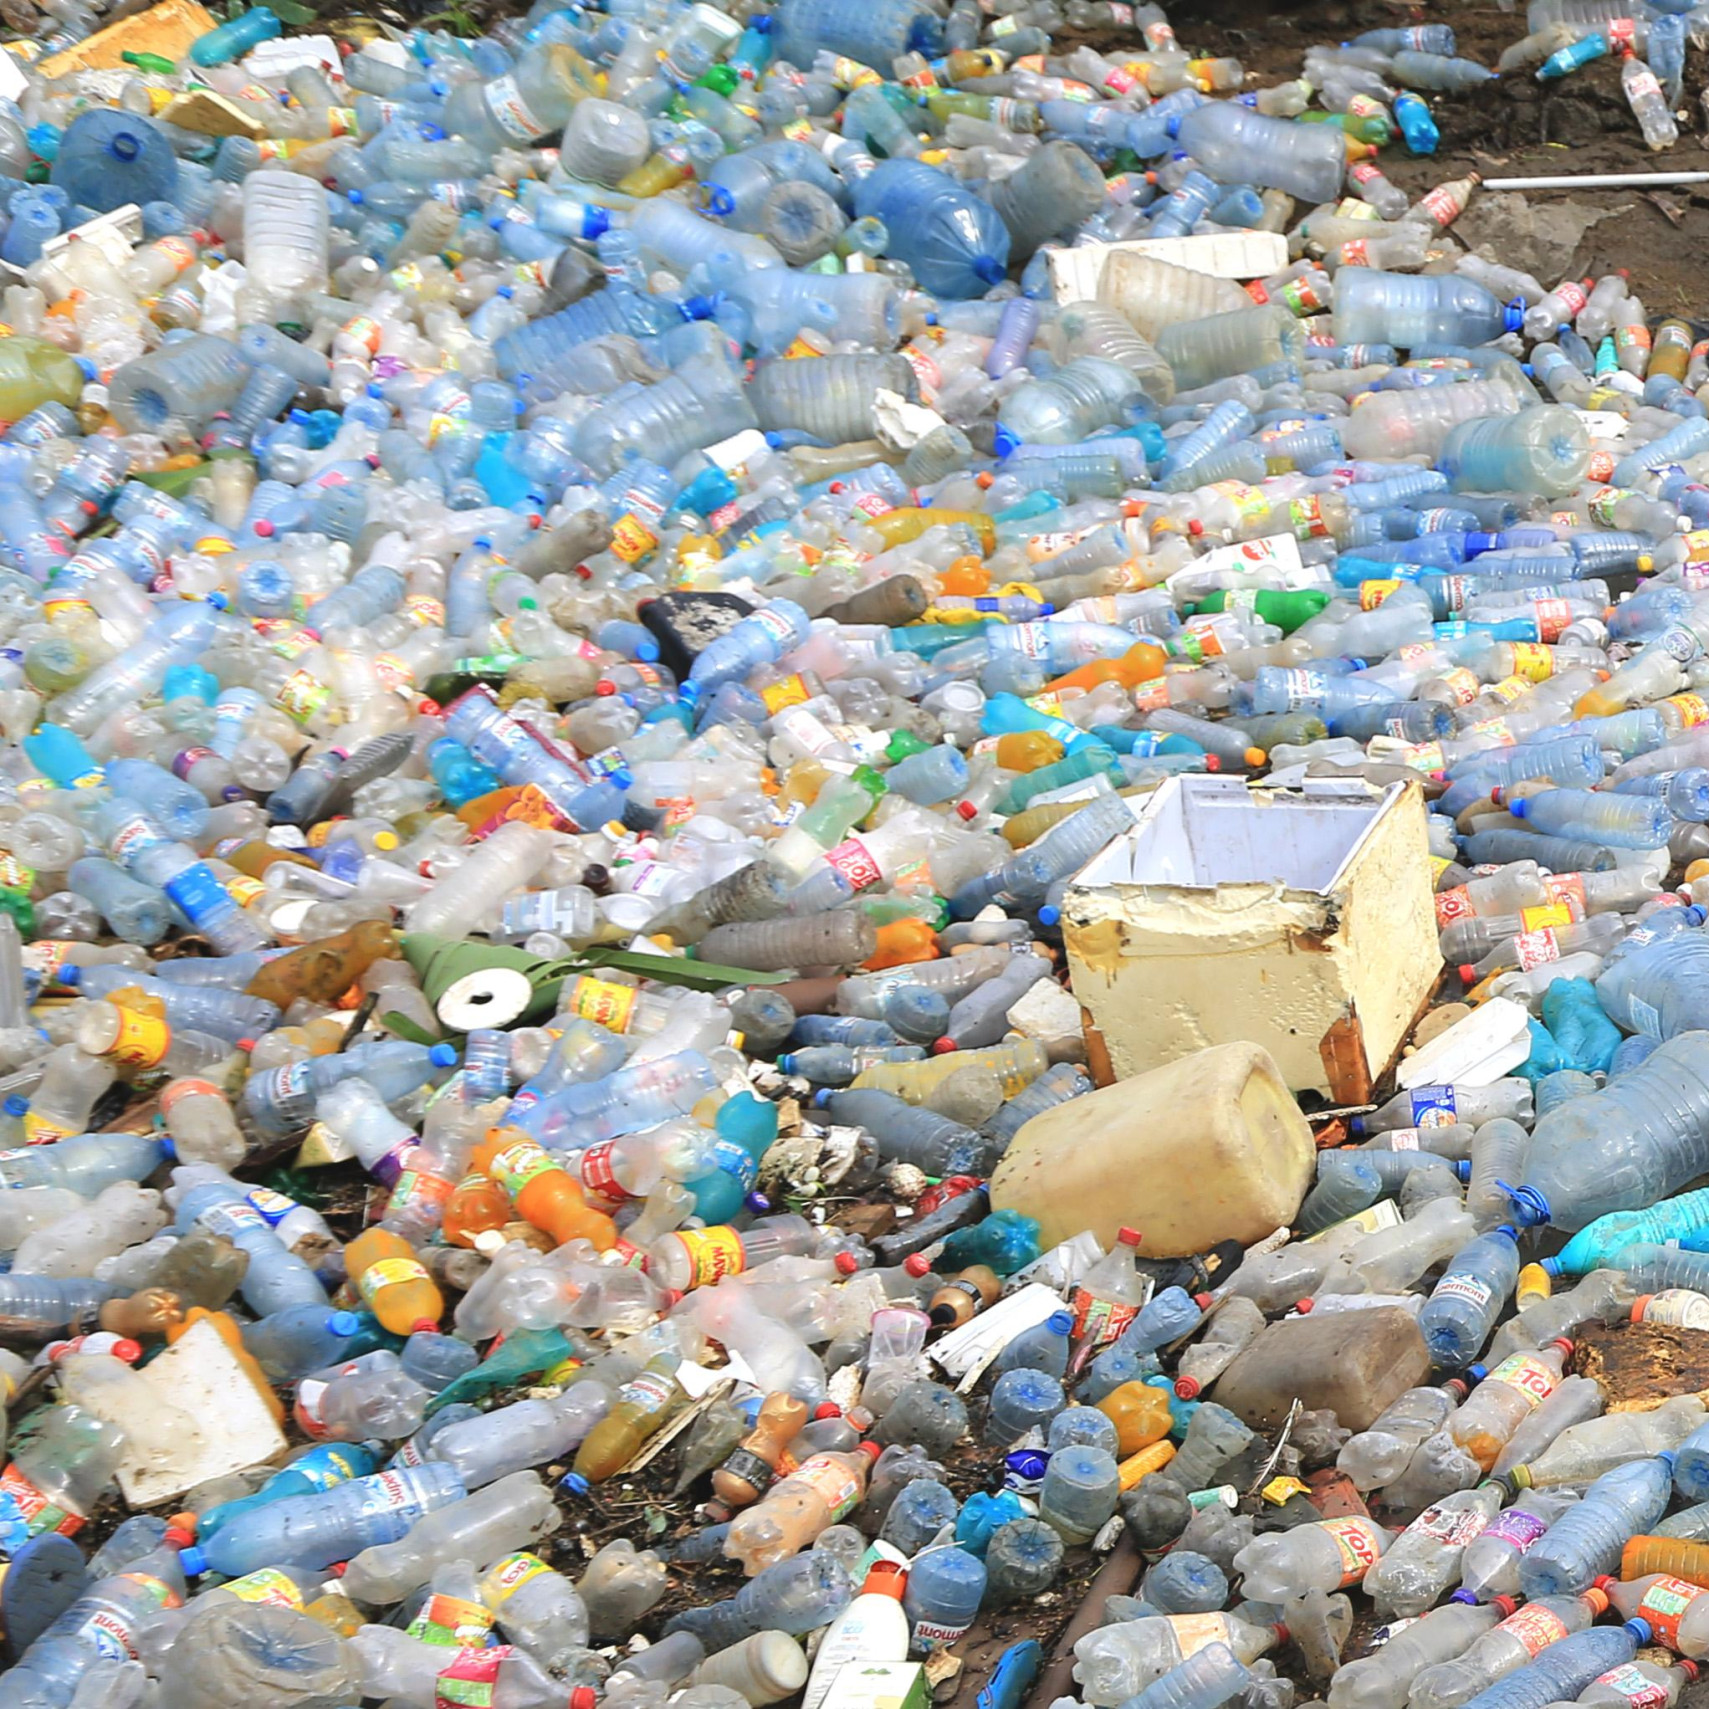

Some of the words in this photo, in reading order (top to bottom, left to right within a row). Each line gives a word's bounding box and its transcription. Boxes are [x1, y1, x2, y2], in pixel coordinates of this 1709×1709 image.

[839, 858, 875, 886] TOP
[1435, 893, 1464, 921] TOP
[1339, 1522, 1376, 1566] TOP
